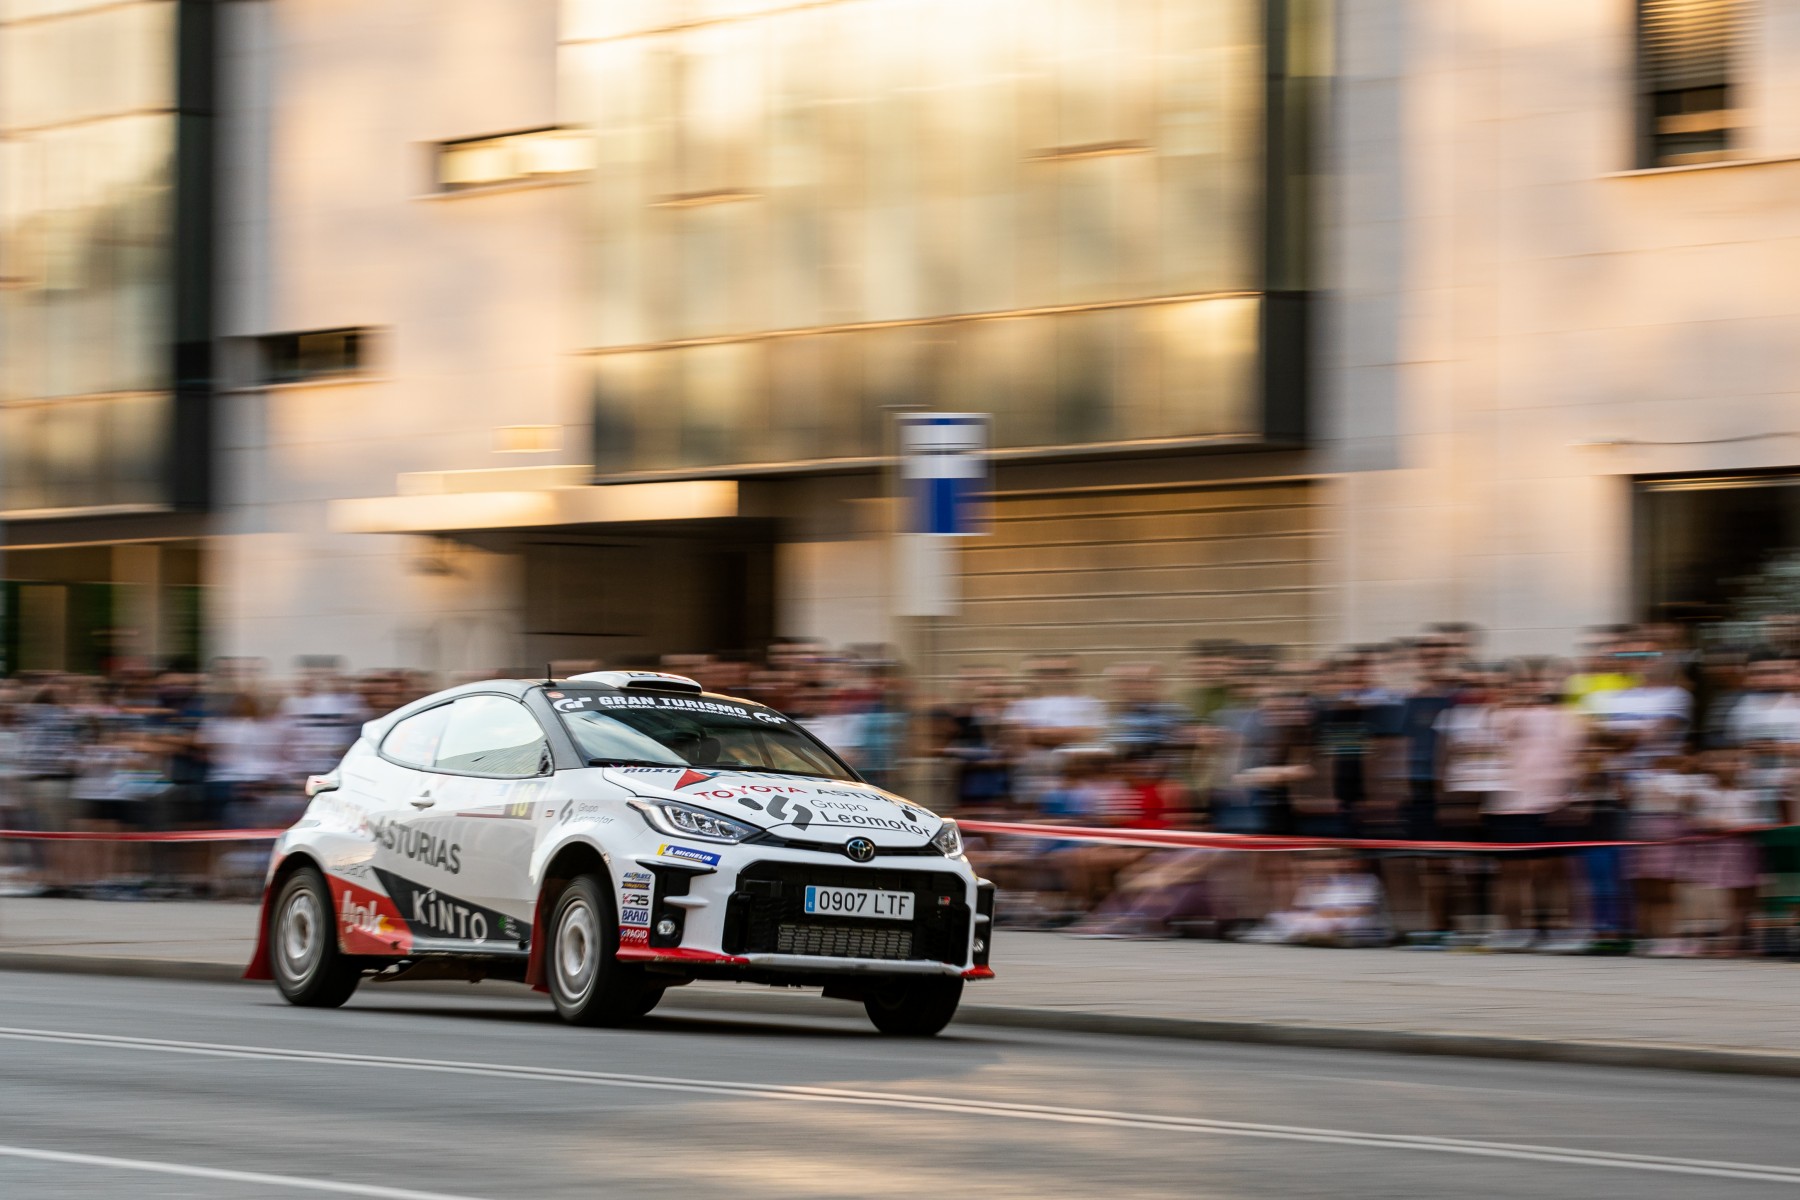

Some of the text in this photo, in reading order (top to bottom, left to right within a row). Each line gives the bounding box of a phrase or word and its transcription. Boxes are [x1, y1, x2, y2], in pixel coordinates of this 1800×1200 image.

[599, 696, 748, 716] GRAN TURISMO
[693, 785, 808, 801] TOYOTA
[810, 799, 869, 812] Grupo
[820, 811, 931, 838] Leomotor
[367, 815, 461, 874] ASTURIAS
[674, 849, 714, 862] MICHELIN
[819, 891, 868, 913] 0907
[874, 893, 910, 916] LTF
[622, 909, 649, 924] BRAID
[626, 928, 648, 940] PAGID
